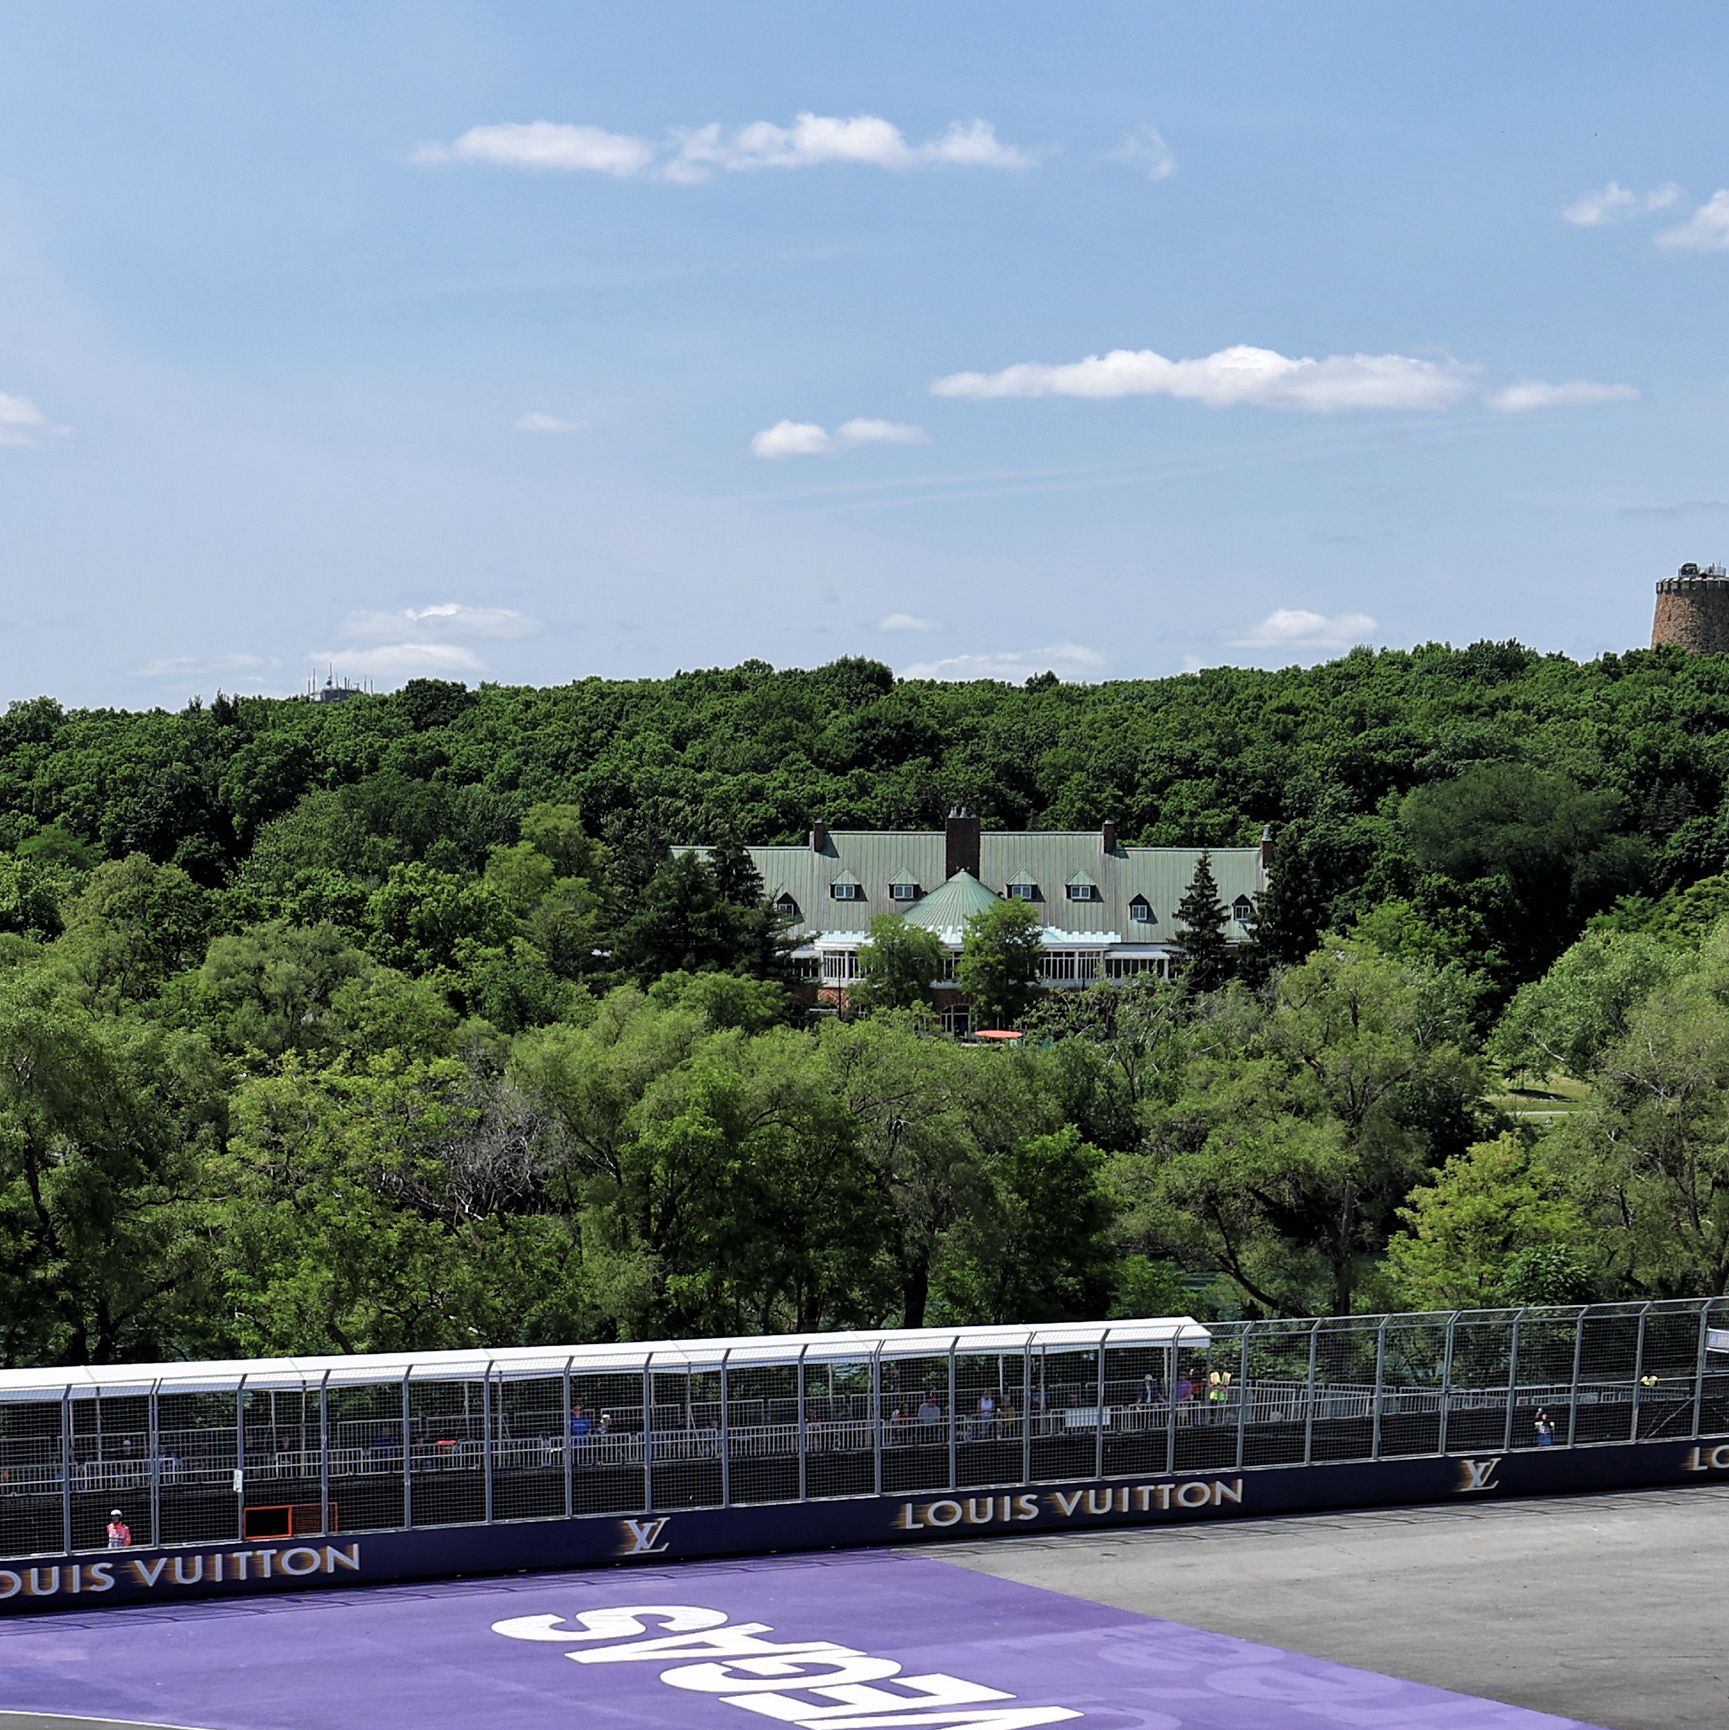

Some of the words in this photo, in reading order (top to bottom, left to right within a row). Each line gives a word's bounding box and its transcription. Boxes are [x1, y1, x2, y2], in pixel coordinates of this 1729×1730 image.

[903, 1491, 1041, 1531] LOUIS
[1057, 1477, 1245, 1518] VUITTON
[136, 1543, 362, 1589] VUITTON
